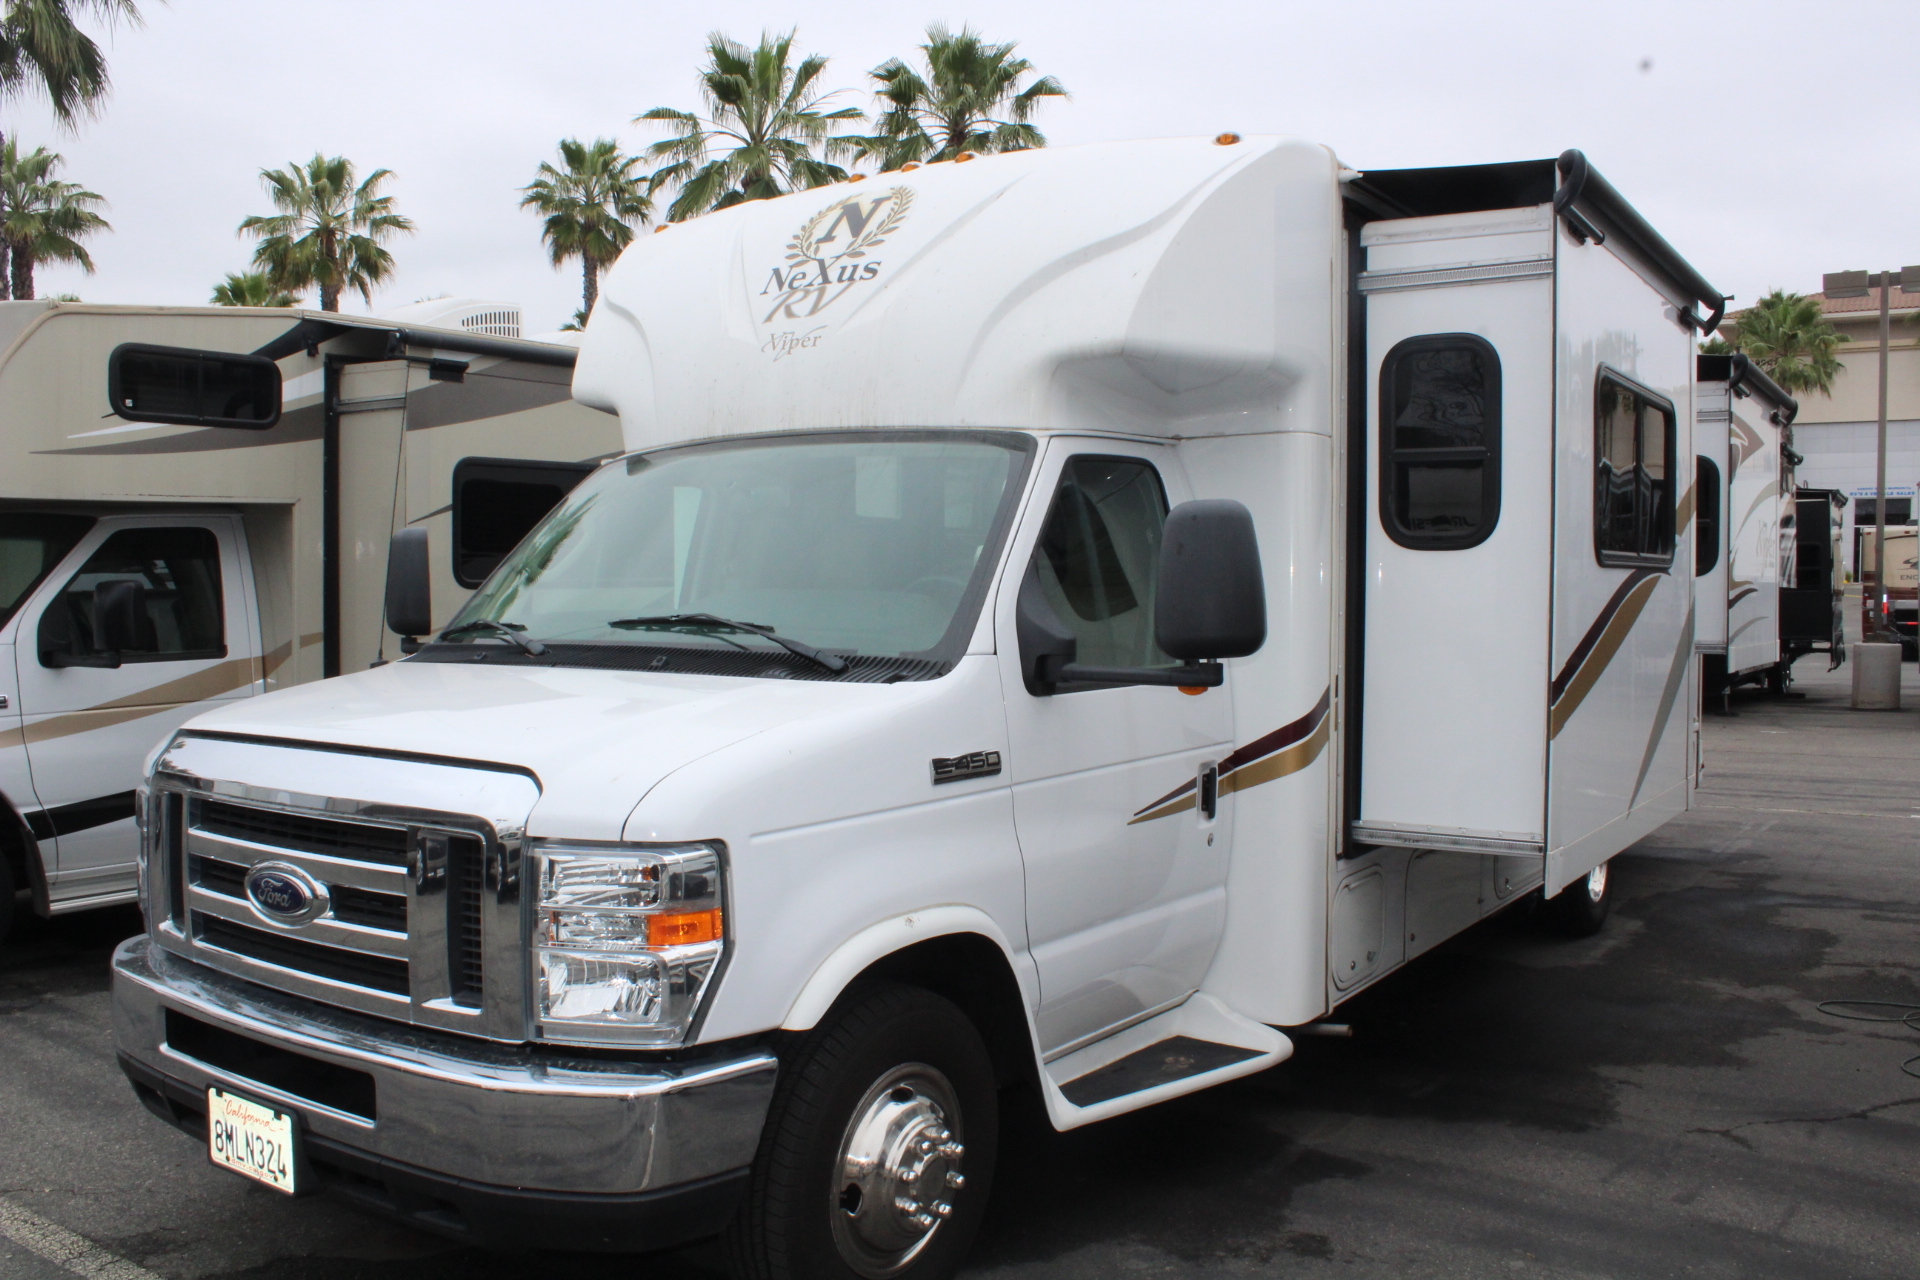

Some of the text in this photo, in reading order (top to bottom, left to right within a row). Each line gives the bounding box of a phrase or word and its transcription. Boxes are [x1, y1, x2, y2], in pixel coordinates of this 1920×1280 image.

[760, 256, 882, 295] NeXus
[762, 284, 856, 325] RV
[761, 325, 828, 362] Viper
[258, 877, 293, 908] Ford
[225, 1099, 276, 1132] California
[214, 1119, 287, 1179] 8MLN324
